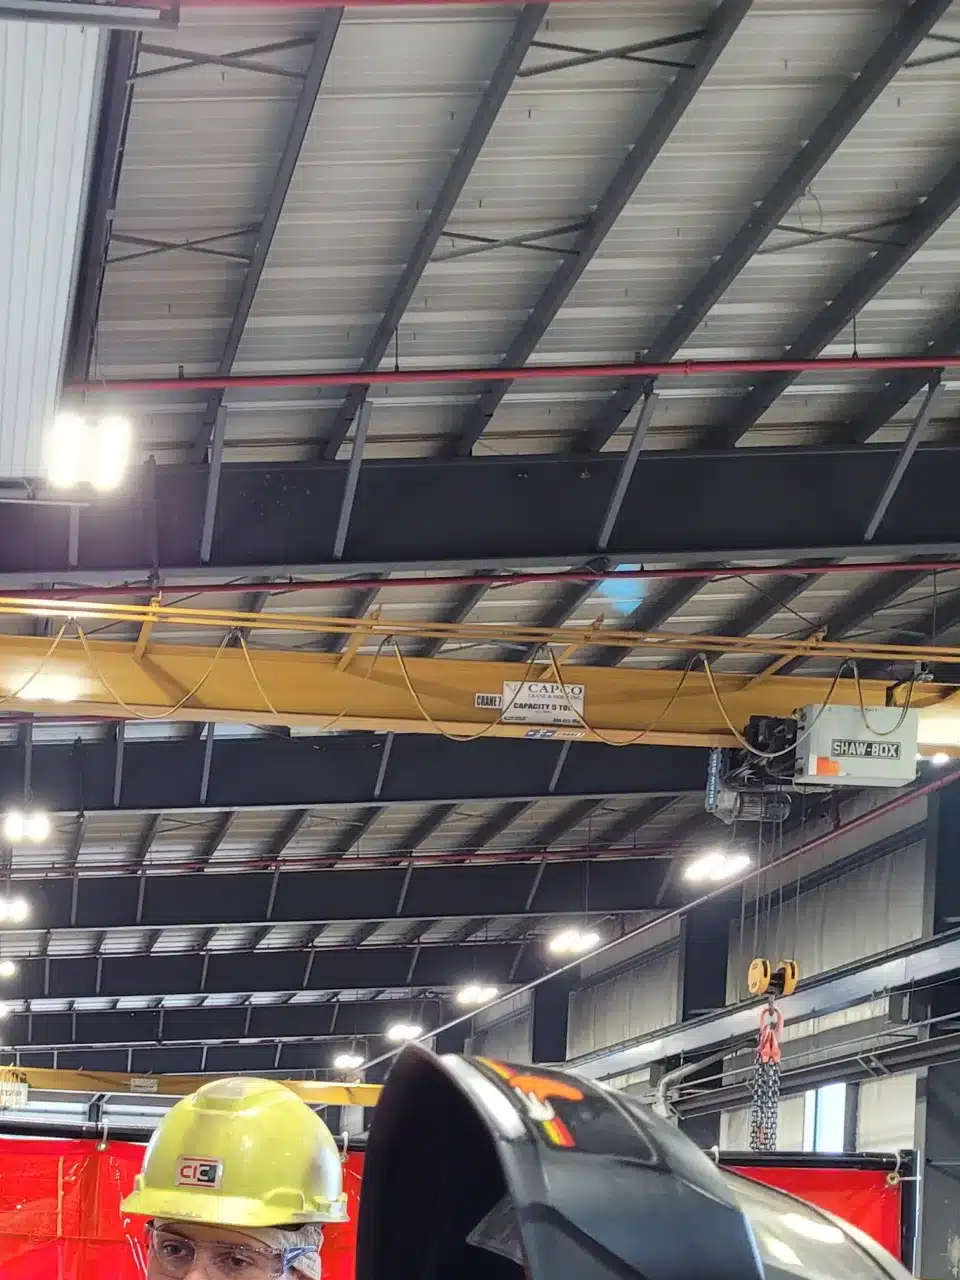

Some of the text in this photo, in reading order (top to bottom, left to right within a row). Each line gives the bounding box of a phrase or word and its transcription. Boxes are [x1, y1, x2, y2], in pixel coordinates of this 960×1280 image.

[528, 684, 583, 696] CAPCO
[477, 695, 497, 706] CRANE
[513, 702, 549, 711] CAPACITY
[551, 703, 557, 711] 5
[832, 741, 899, 759] SHAW-BOX
